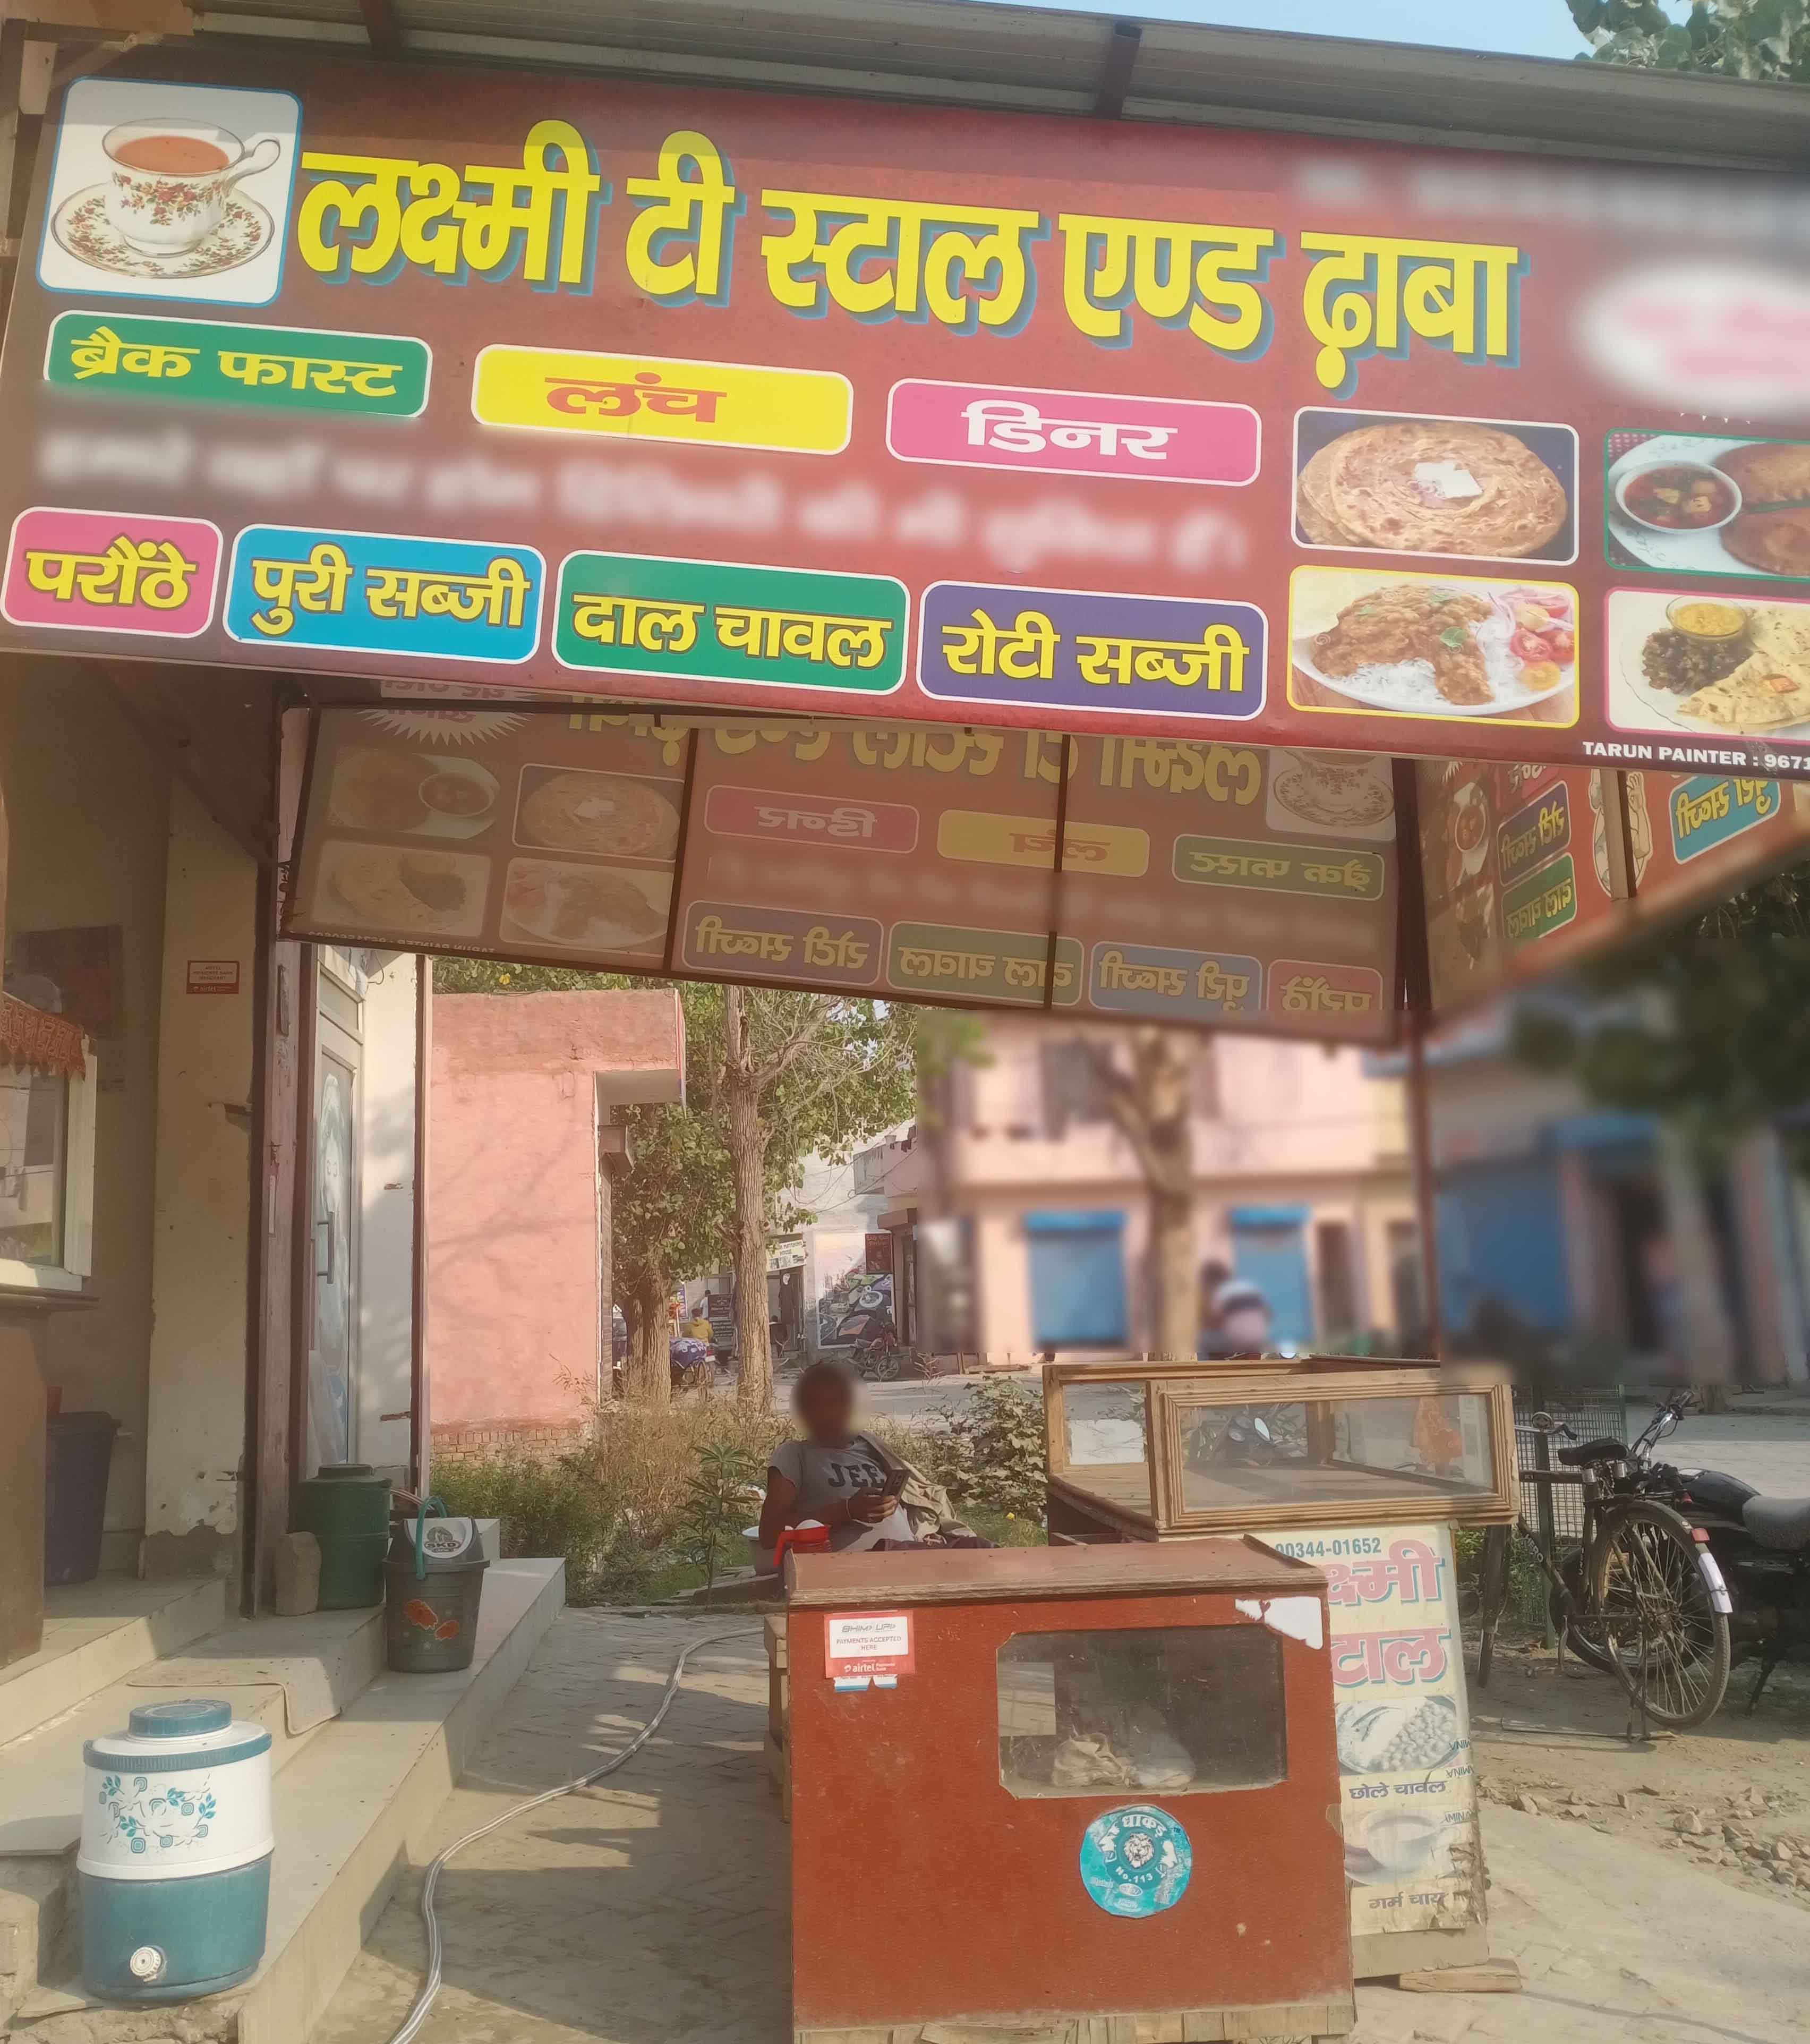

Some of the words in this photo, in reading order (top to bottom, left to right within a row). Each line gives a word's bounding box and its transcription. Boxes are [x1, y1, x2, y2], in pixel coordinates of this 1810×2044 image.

[298, 120, 601, 285] लक्ष्मी
[626, 131, 736, 296] टी
[761, 189, 1039, 326] स्टाल
[1059, 213, 1275, 351] एण्ड
[71, 326, 200, 380] ब्रैक
[218, 350, 403, 397] फास्ट
[544, 372, 727, 423] लंच
[961, 399, 1178, 461] डिनर
[24, 534, 197, 610] परौंठे
[251, 542, 354, 637] पुरी
[364, 556, 532, 628] सब्जी
[571, 592, 705, 653] दाल
[714, 603, 895, 669] चावल
[940, 608, 1061, 680] रोटी
[1075, 623, 1251, 692] सब्जी
[1582, 742, 1652, 759] TARUN
[1659, 746, 1746, 765] PAINTER
[1328, 1539, 1443, 1605] क्ष्मी
[852, 1663, 875, 1673] airtel
[1330, 1627, 1450, 1687] टाल
[1349, 1782, 1389, 1800] छोले
[1394, 1780, 1448, 1795] चावल
[1368, 1890, 1404, 1910] गर्म
